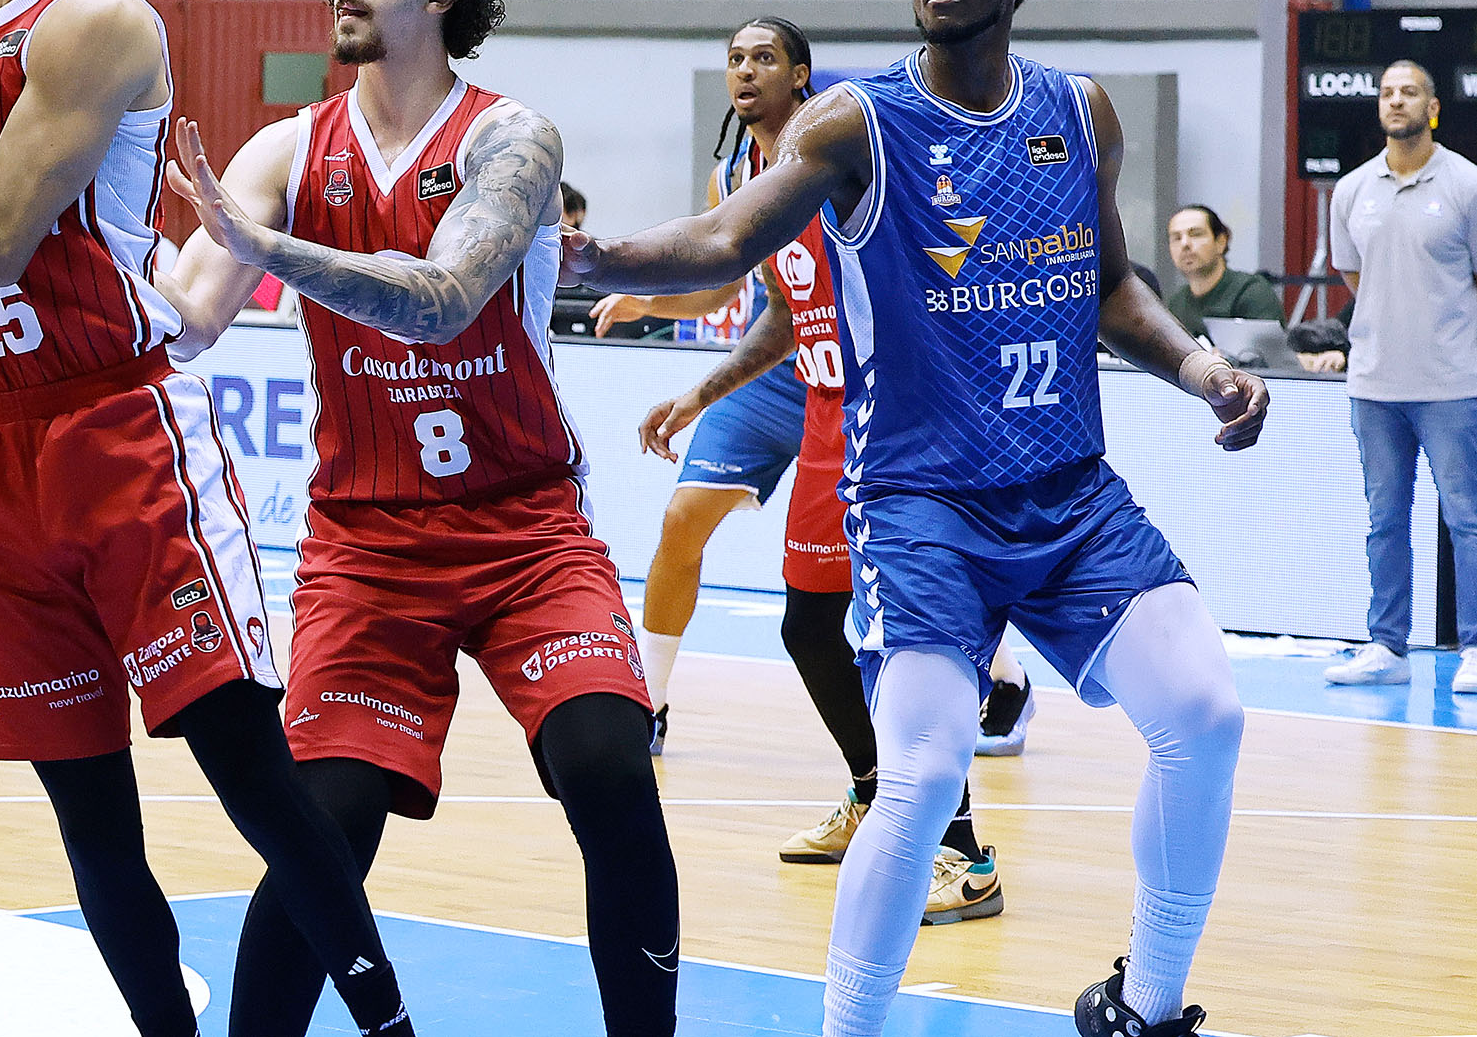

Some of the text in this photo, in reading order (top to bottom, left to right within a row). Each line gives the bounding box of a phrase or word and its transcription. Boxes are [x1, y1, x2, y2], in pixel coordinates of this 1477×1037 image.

[1308, 72, 1379, 97] LOCAL
[1031, 145, 1048, 155] liga
[1033, 151, 1066, 161] endesa
[422, 178, 436, 190] liga
[422, 182, 452, 195] endesa
[951, 272, 1084, 313] BURGOS
[342, 343, 507, 381] Casademont
[1000, 339, 1060, 409] 22
[387, 383, 463, 403] ZARAGOZA
[413, 408, 472, 478] 8
[258, 481, 296, 525] de
[787, 539, 850, 555] azulmarin
[176, 589, 201, 607] acb
[138, 626, 185, 663] Zaragoza
[543, 630, 621, 655] Zaragoza
[48, 686, 104, 711] new travel
[320, 690, 423, 726] azulmarino
[289, 713, 320, 728] MERCURY
[376, 715, 424, 741] new travel
